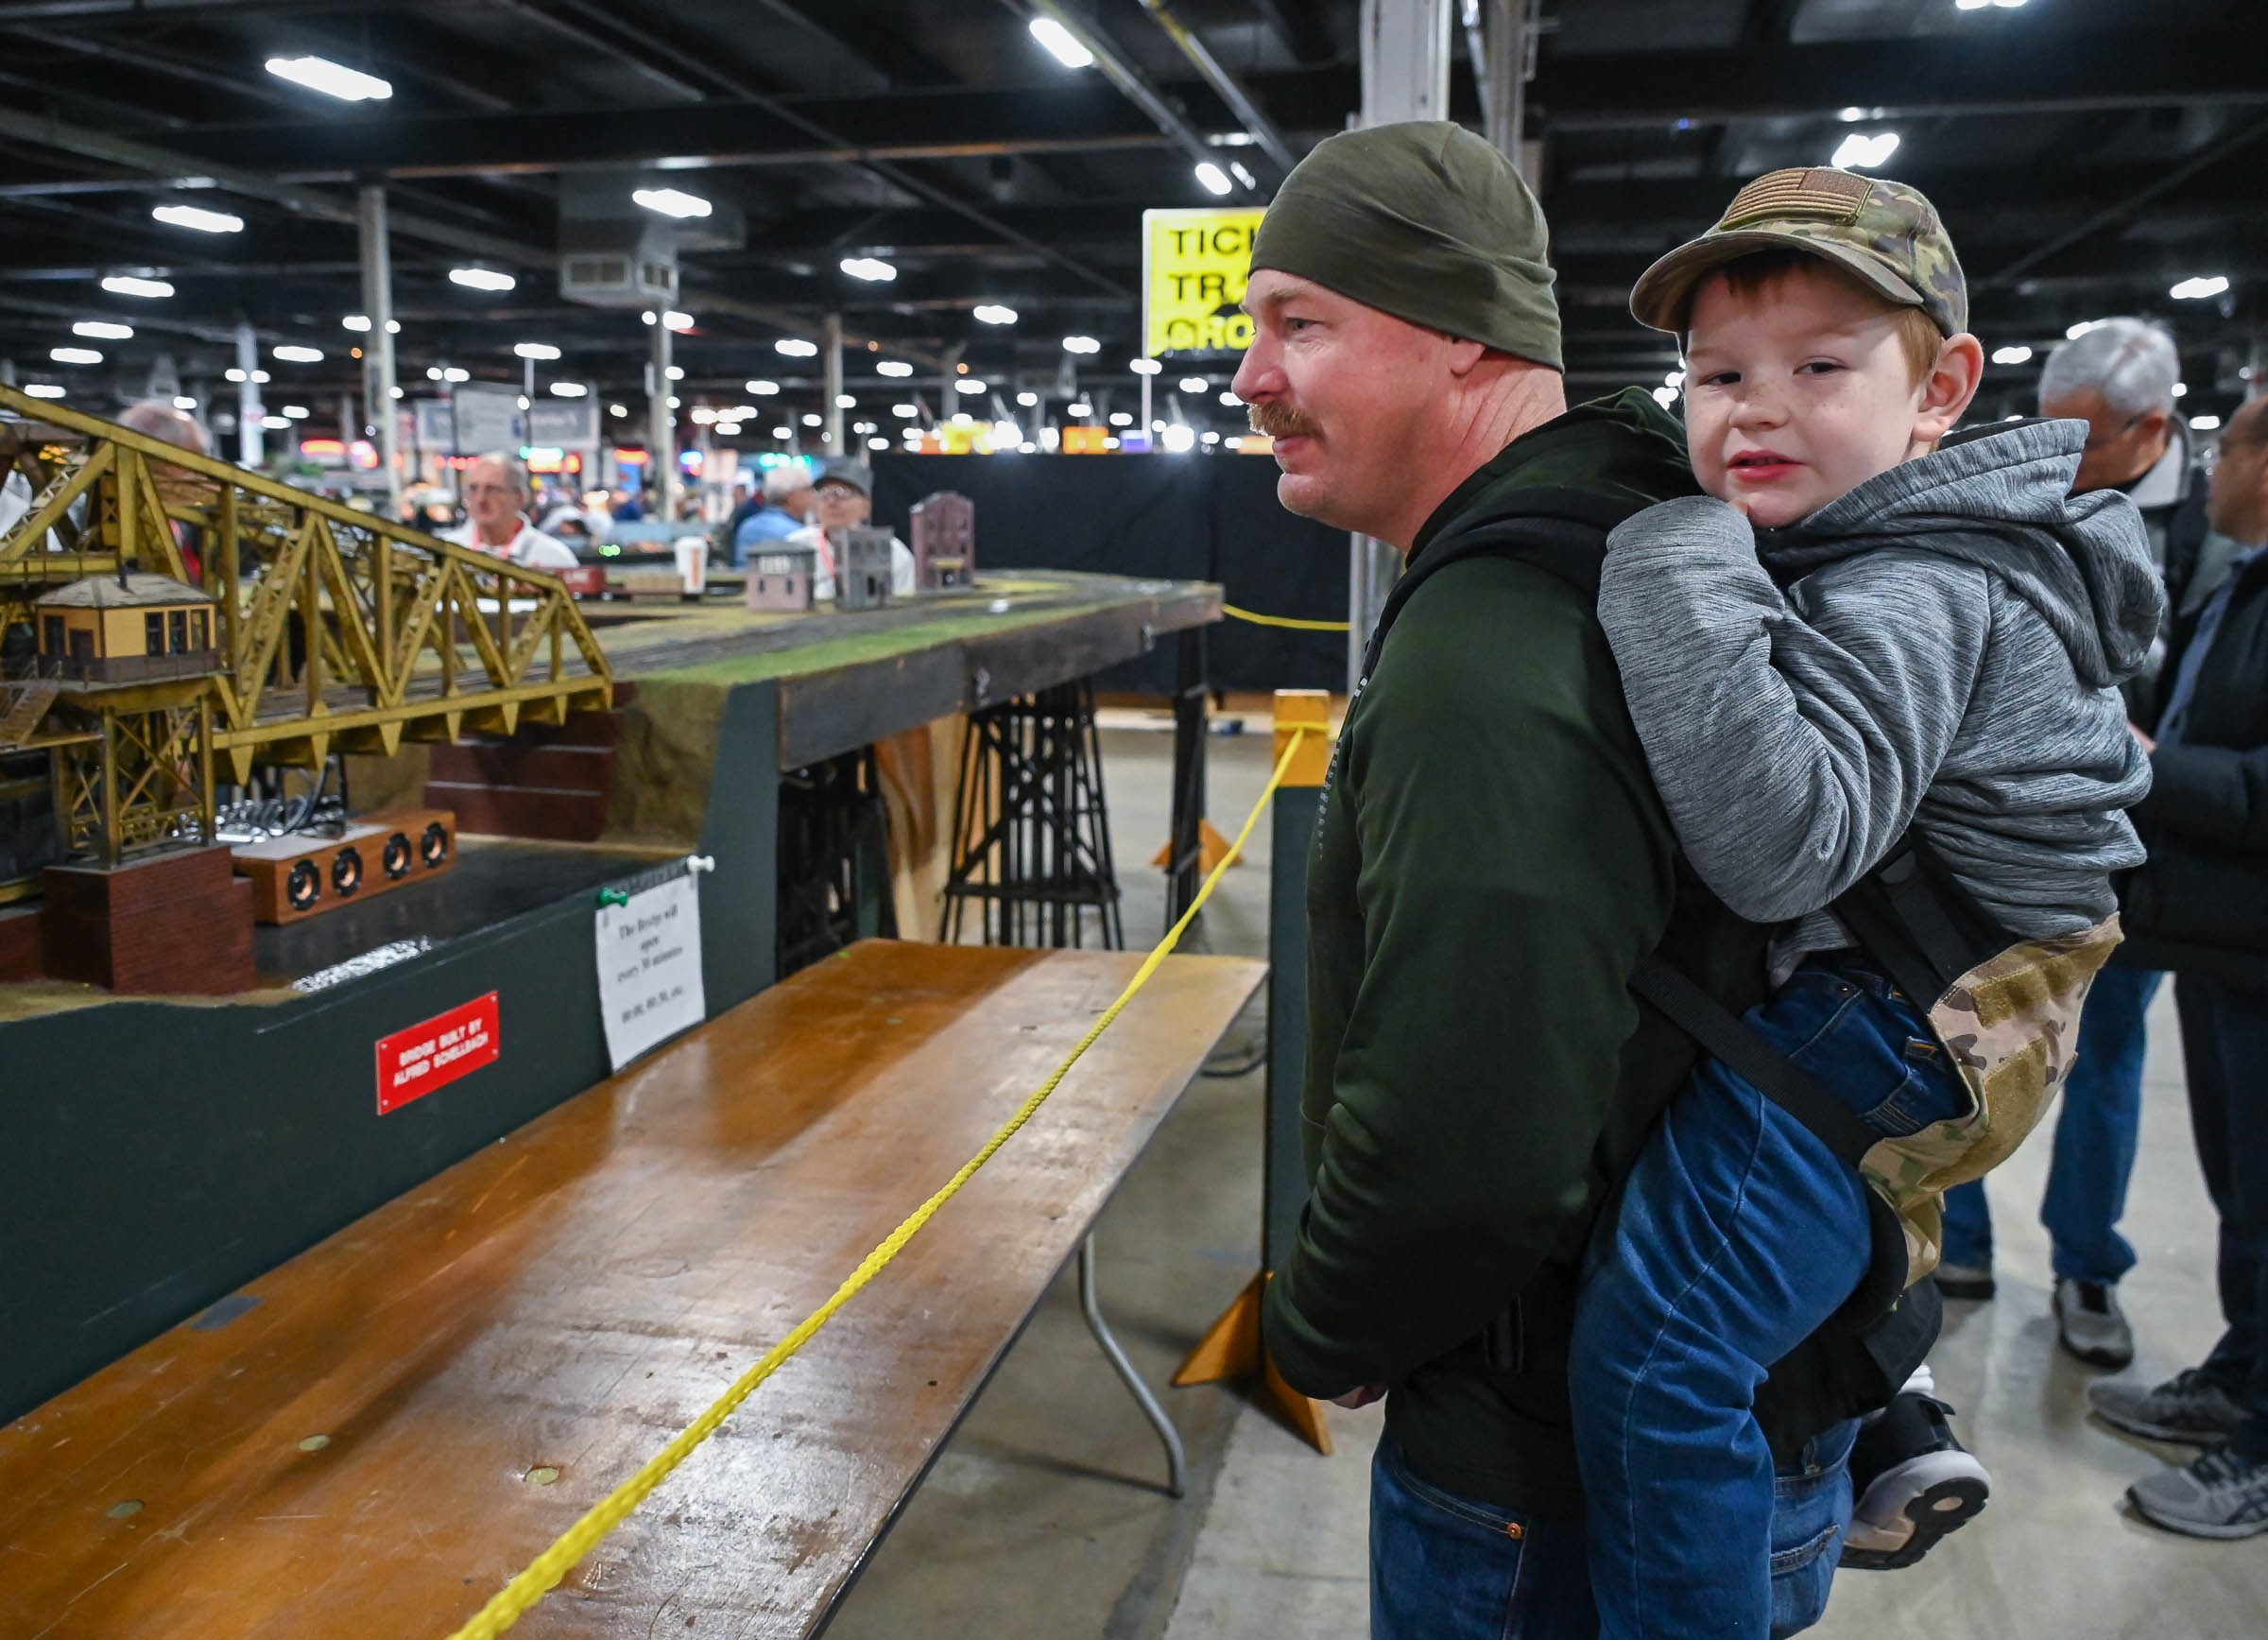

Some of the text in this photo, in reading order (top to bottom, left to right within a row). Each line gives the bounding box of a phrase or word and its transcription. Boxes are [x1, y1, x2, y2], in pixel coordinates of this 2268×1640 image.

[1169, 227, 1256, 255] TIC
[1168, 273, 1248, 302] TR
[400, 1017, 482, 1067] BRIDGE BUILT BY
[393, 1059, 431, 1088] ALFRED
